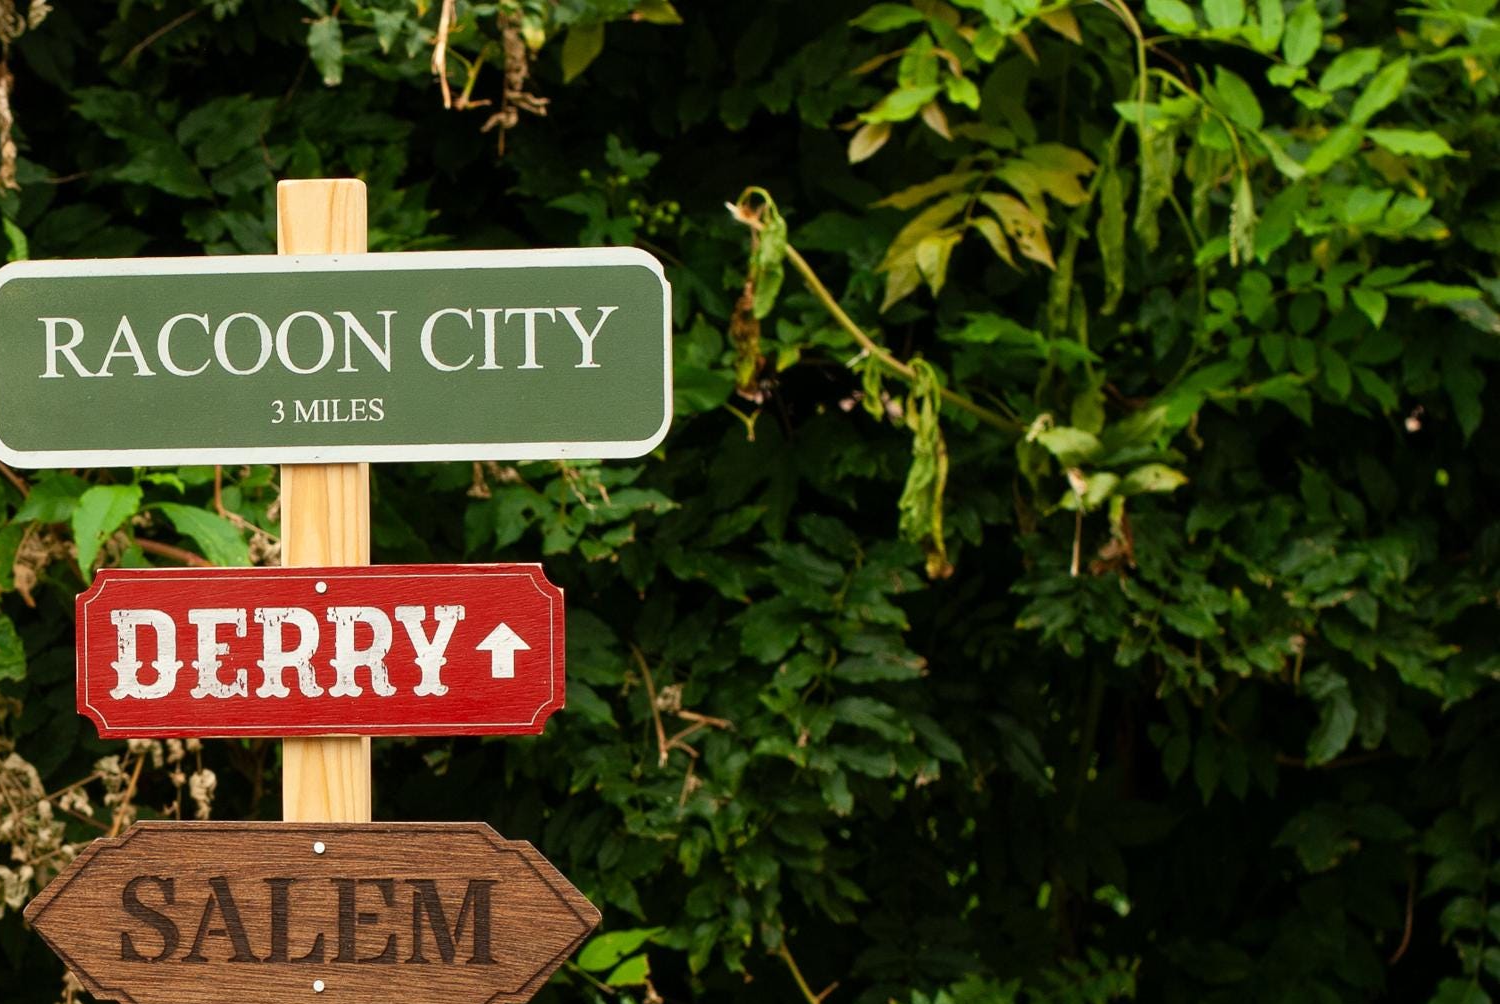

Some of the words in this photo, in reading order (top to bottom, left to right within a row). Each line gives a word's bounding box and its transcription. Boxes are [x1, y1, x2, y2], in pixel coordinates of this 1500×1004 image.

[37, 308, 398, 379] RACOON
[420, 305, 619, 372] CITY
[271, 399, 286, 425] 3
[293, 398, 385, 424] MILES
[108, 604, 466, 700] DERRY
[120, 874, 500, 966] SALEM
